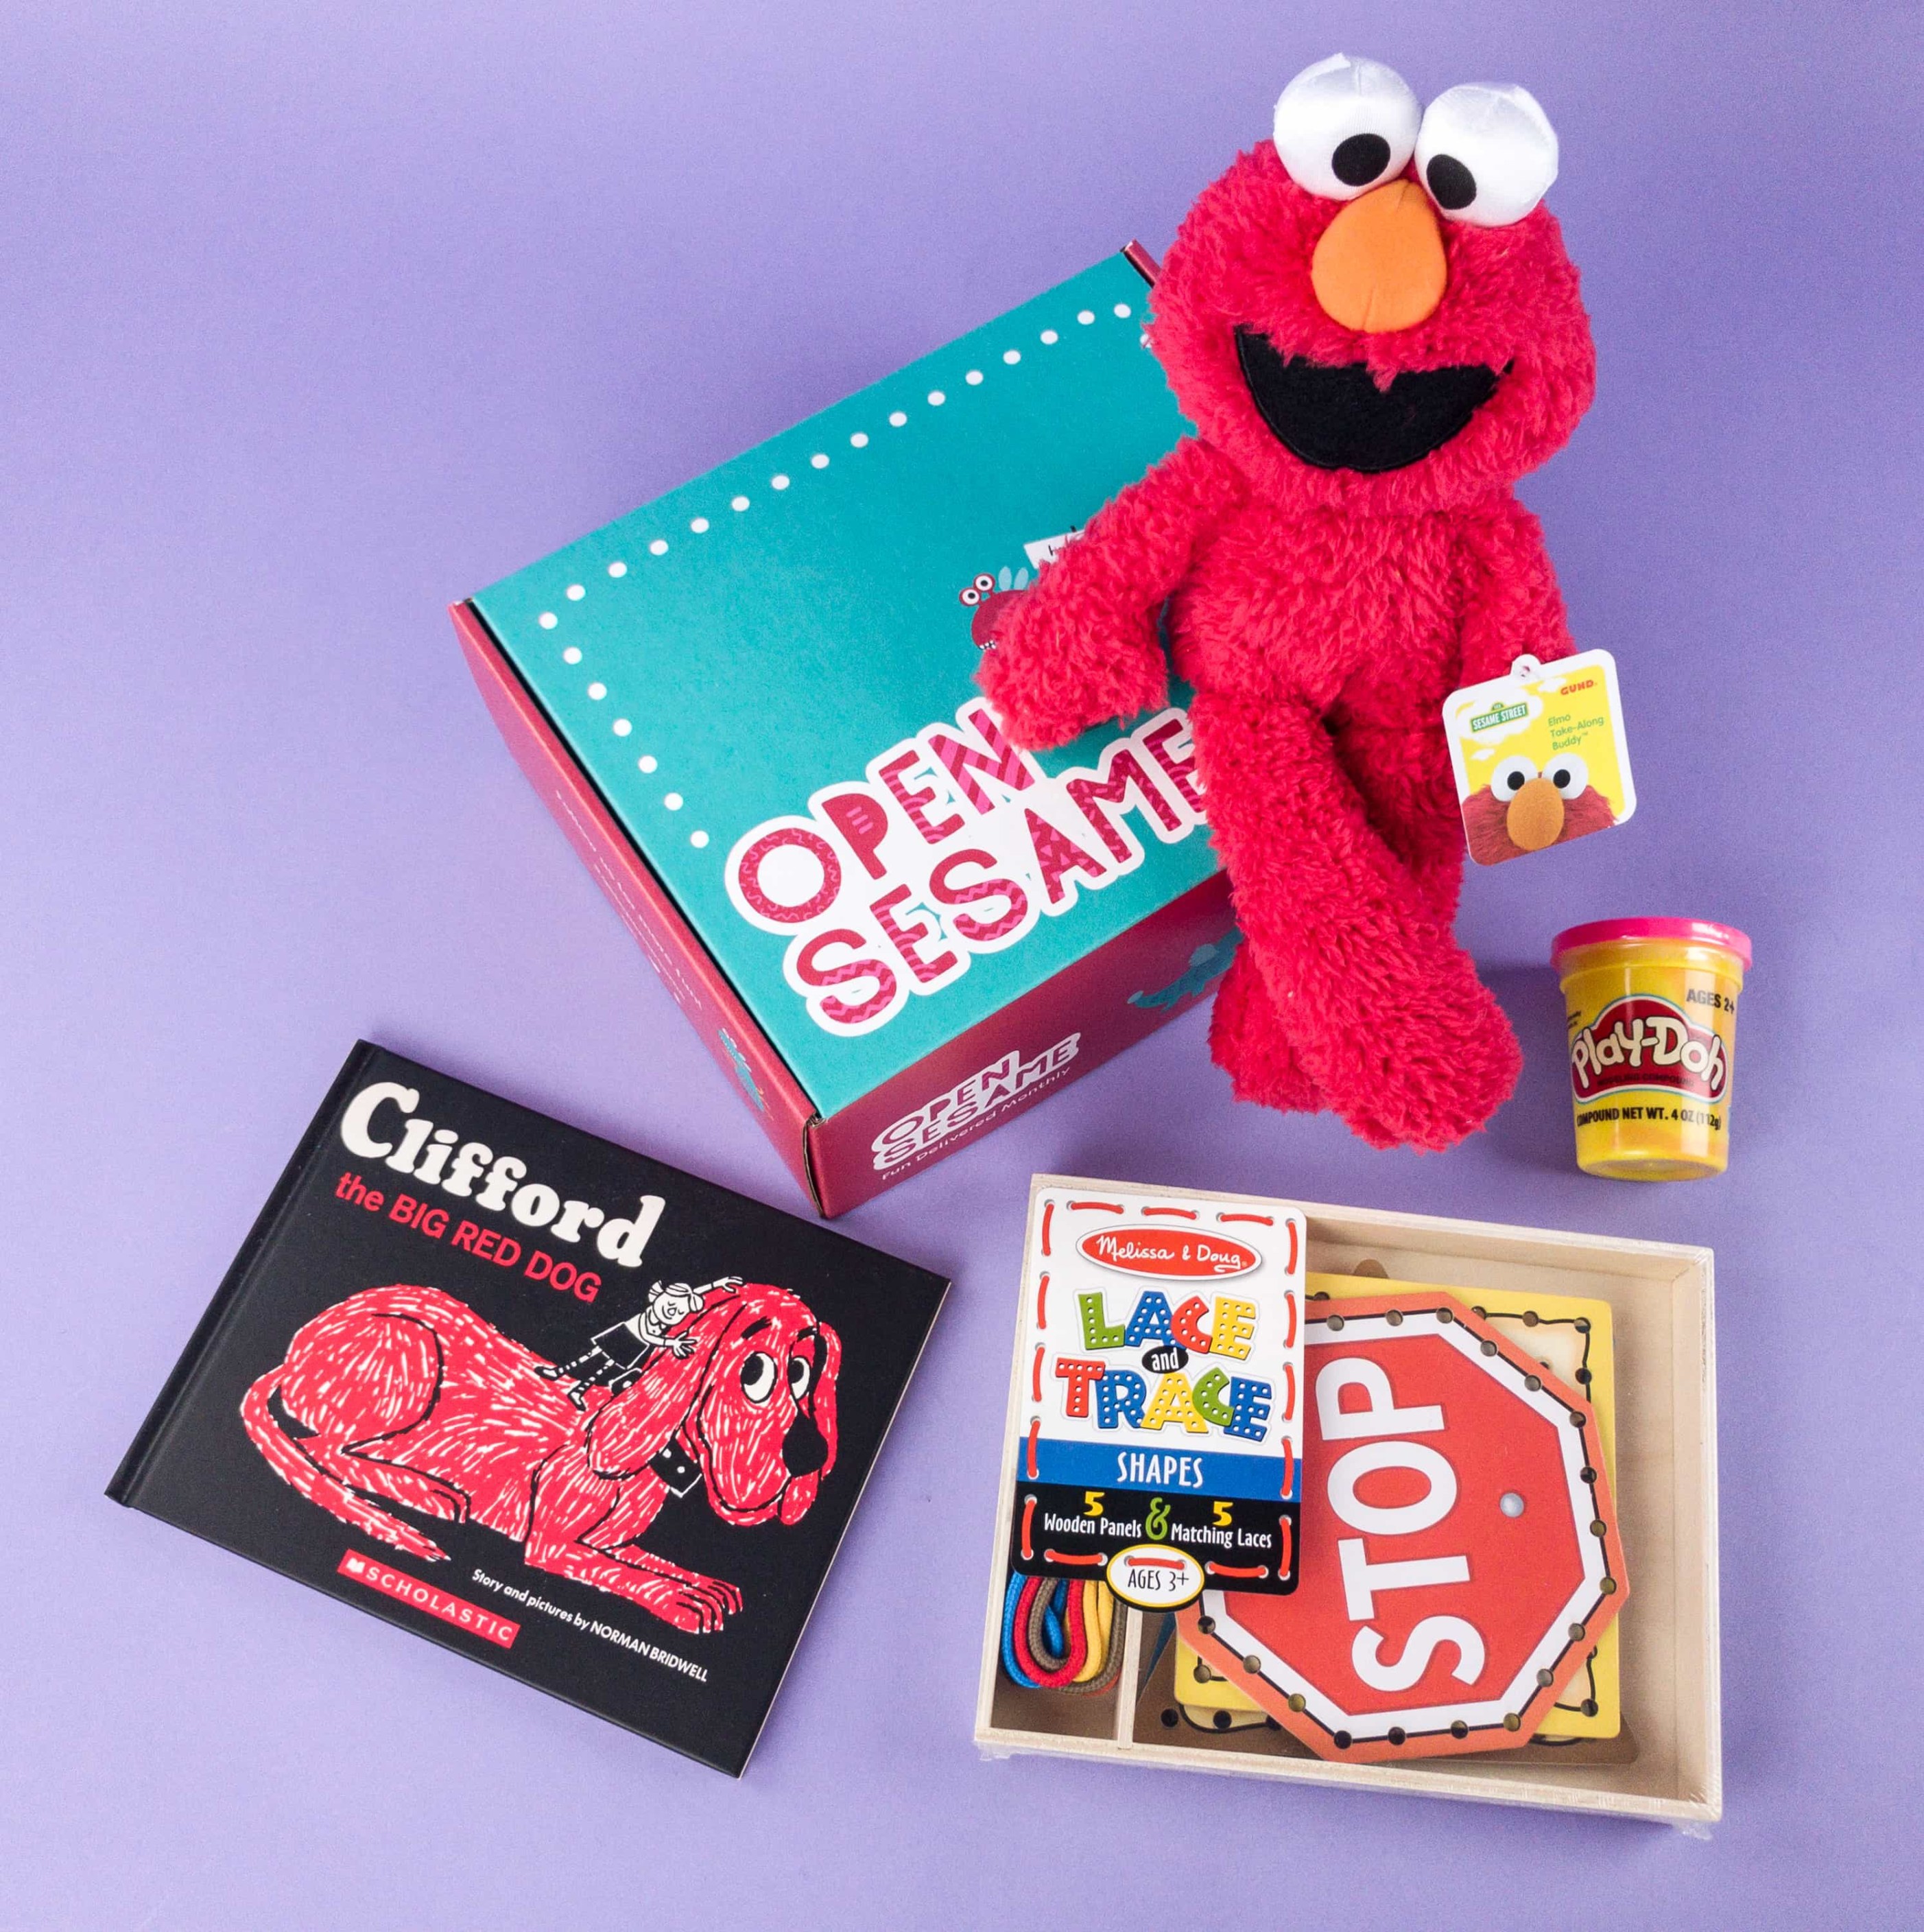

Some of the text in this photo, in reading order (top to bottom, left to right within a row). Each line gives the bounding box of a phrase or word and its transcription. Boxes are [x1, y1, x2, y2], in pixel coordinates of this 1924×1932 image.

[1473, 705, 1525, 730] SESAME STREET
[1548, 714, 1571, 727] Elmo
[1550, 717, 1604, 737] Take-Along
[738, 709, 1034, 923] OPEN
[796, 718, 1205, 1024] SESAME
[1686, 989, 1735, 1015] AGES 2+
[1571, 1016, 1724, 1090] Play-Doh
[882, 1059, 1010, 1145] OPEN
[883, 1037, 1076, 1165] SESAME
[1622, 1107, 1643, 1120] NET
[1671, 1109, 1678, 1120] 4
[1680, 1109, 1694, 1122] OZ
[882, 1067, 1071, 1180] Fun Delivered Monthly
[340, 1081, 666, 1268] Clifford
[335, 1172, 602, 1303] the BIG RED DOG
[1096, 1235, 1176, 1261] Melissa
[1182, 1246, 1190, 1260] &
[1078, 1291, 1256, 1360] LACE
[1151, 1347, 1179, 1371] and
[1055, 1357, 1272, 1442] TRACE
[1117, 1452, 1203, 1489] SHAPES
[1044, 1513, 1142, 1538] Wooden Panels
[1083, 1491, 1105, 1516] 5
[1145, 1497, 1171, 1541] &
[1213, 1501, 1233, 1527] 5
[1315, 1357, 1486, 1693] STOP
[1171, 1523, 1272, 1549] Matching Laces
[1128, 1568, 1189, 1592] AGES 3+
[366, 1568, 513, 1642] SCHOLASTIC
[472, 1568, 708, 1682] Story and pictures by NORMAN BRIDWELL
